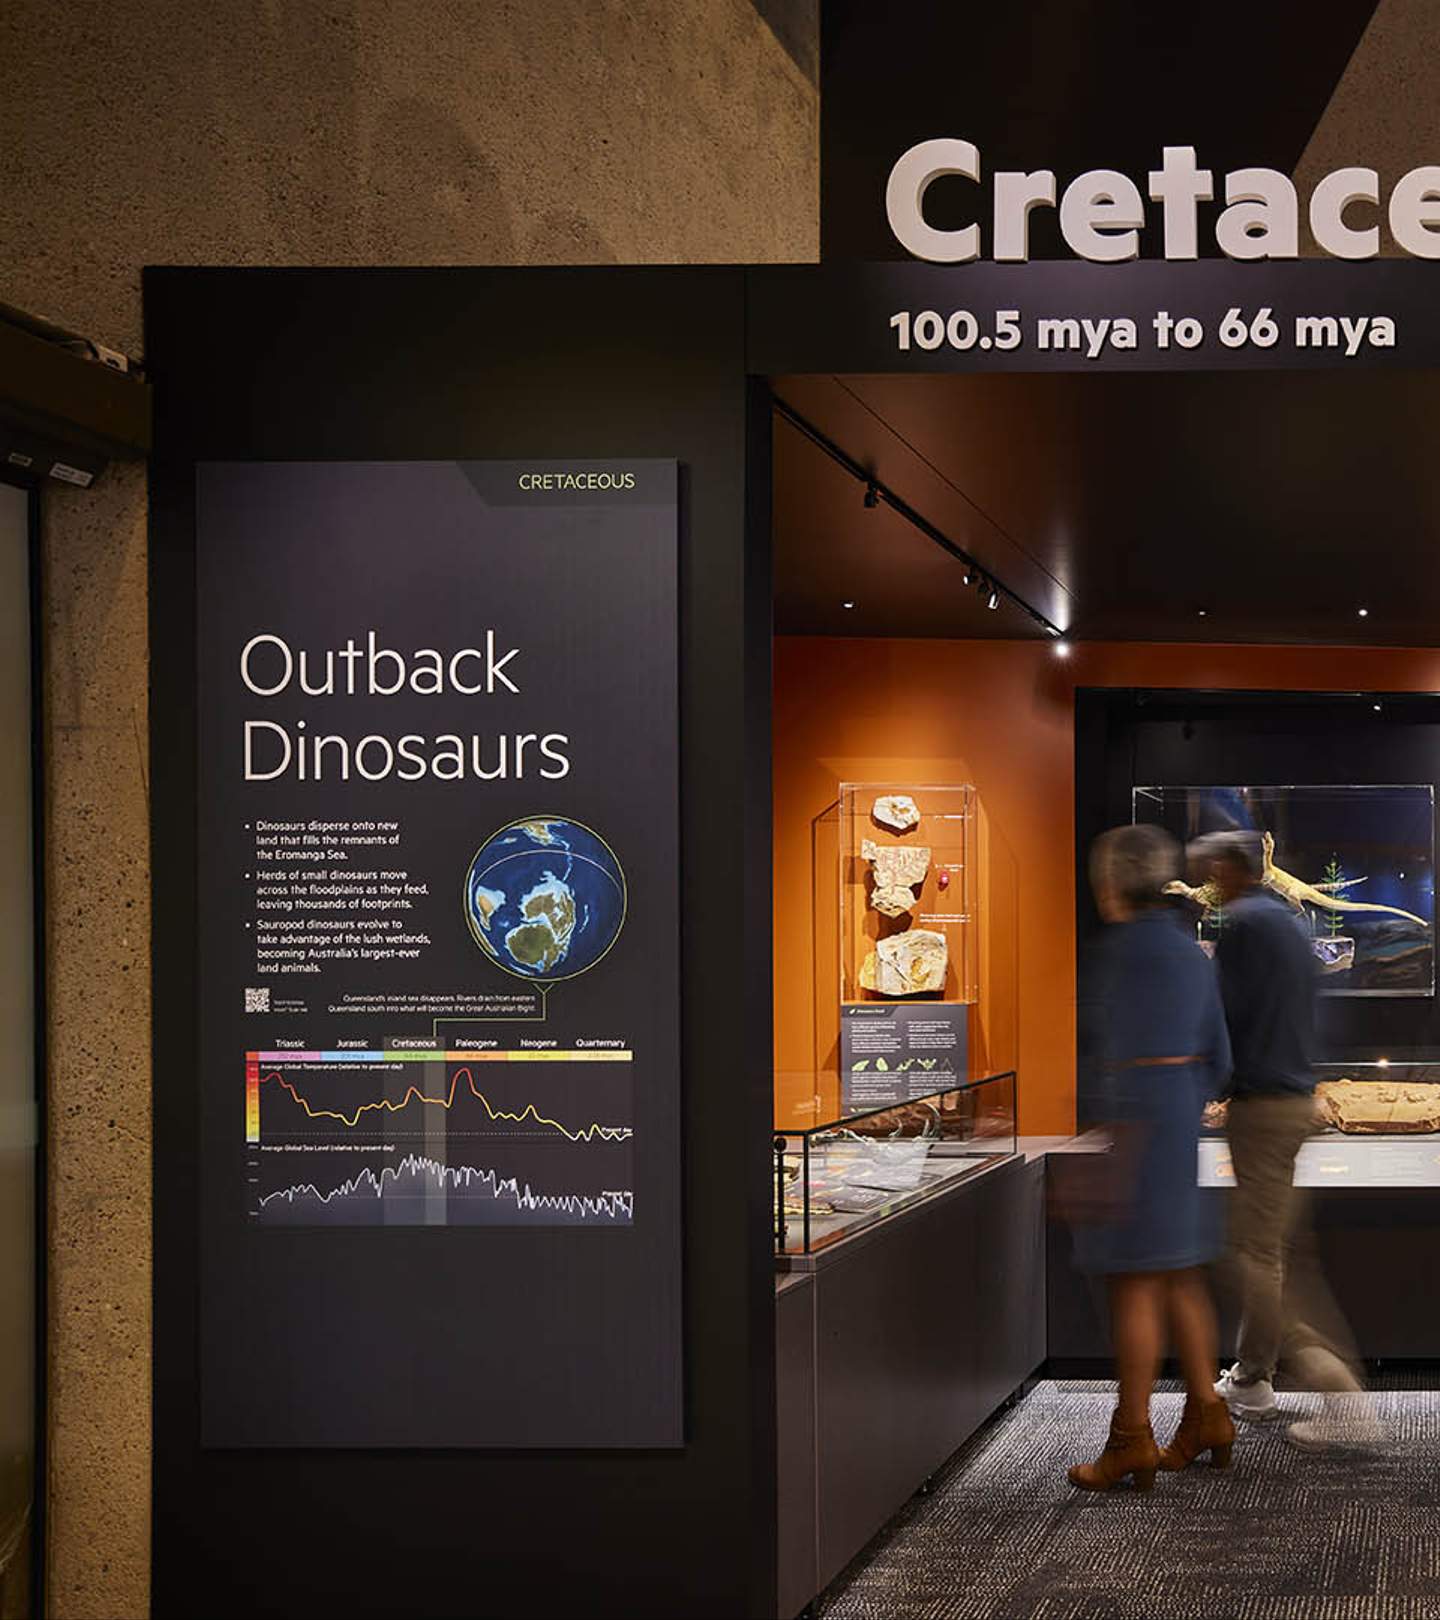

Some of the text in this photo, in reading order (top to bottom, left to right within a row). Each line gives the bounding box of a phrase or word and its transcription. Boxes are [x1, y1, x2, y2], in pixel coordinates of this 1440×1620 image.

[889, 309, 1397, 358] 100.5 mya to 66 mya
[518, 473, 635, 491] CRETACEOUS
[240, 629, 520, 697] Outback
[243, 719, 571, 782] Dinosaurs
[256, 821, 398, 833] Dinosaurs disperse onto new
[256, 835, 400, 845] land that fills the remnants of
[257, 850, 349, 861] the Eromanga Sea.
[256, 870, 407, 880] Herds of small dinosaurs move
[291, 885, 307, 894] the
[309, 885, 364, 897] floodplains
[380, 885, 402, 897] they
[404, 885, 429, 894] feed,
[257, 899, 413, 911] leaving thousands of footprints.
[256, 920, 403, 932] Sauropod dinosaurs evolve to
[257, 934, 431, 946] take advantage of the lush wetlands,
[257, 949, 421, 960] becoming Australia's largest-ever
[257, 963, 321, 972] land animals.
[275, 1039, 305, 1048] Triassic
[336, 1039, 369, 1048] Jurassic
[392, 1039, 437, 1048] Cretaceous
[455, 1038, 498, 1049] Paleogene
[520, 1038, 558, 1049] Neogene
